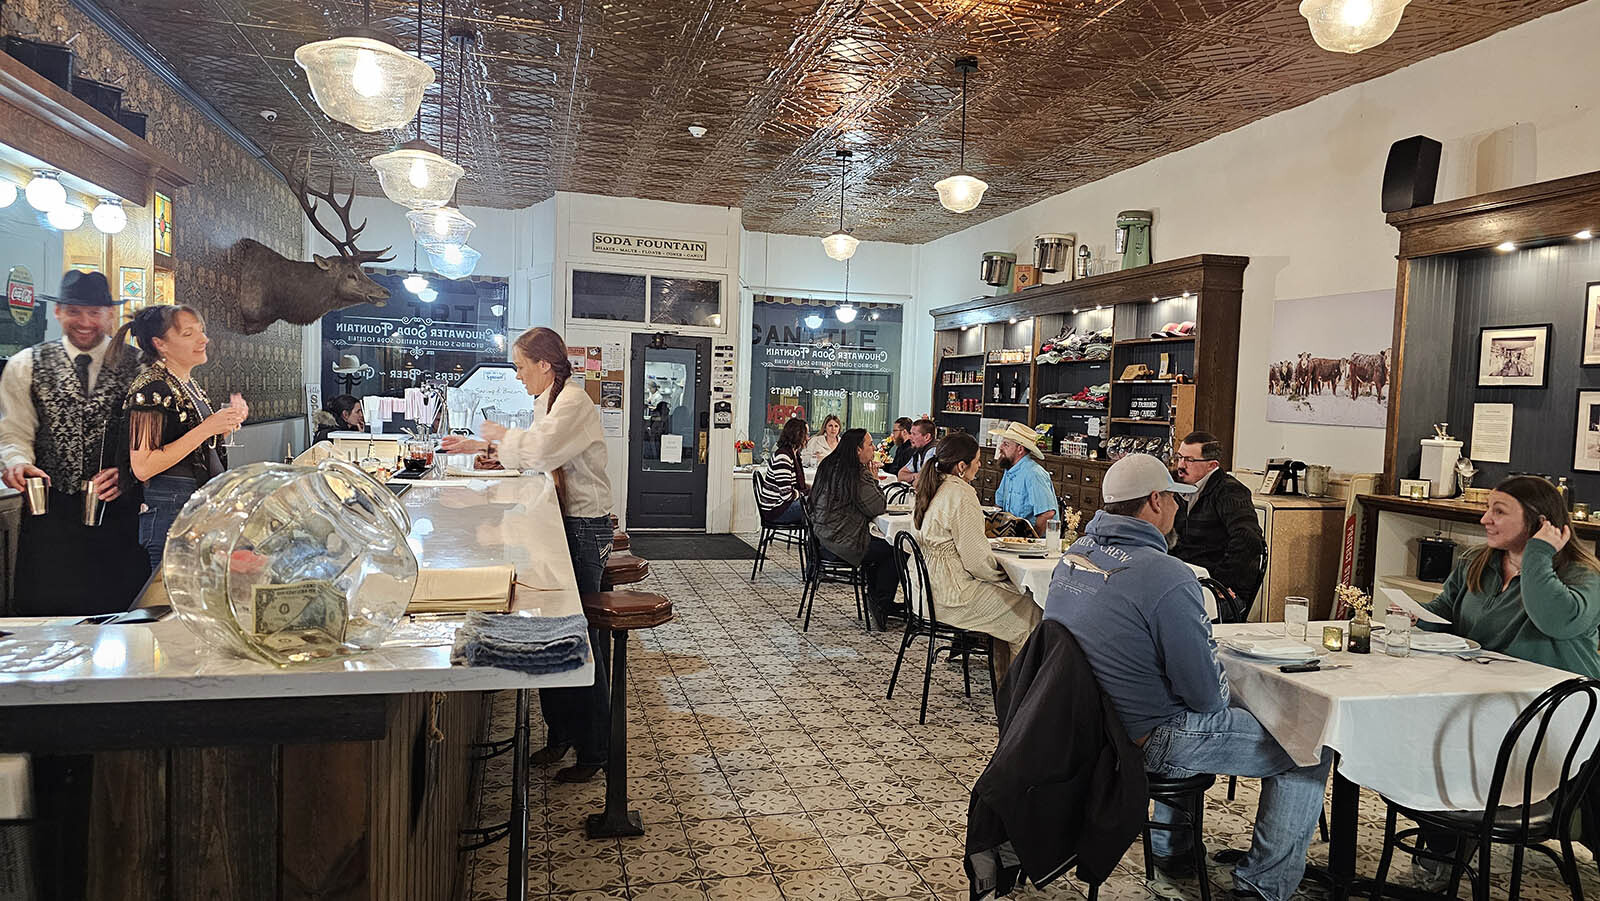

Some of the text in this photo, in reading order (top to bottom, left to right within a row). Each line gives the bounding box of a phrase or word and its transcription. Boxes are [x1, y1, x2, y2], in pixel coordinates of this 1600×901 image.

[595, 235, 704, 252] SODA FOUNTAIN
[1100, 544, 1133, 563] CREW
